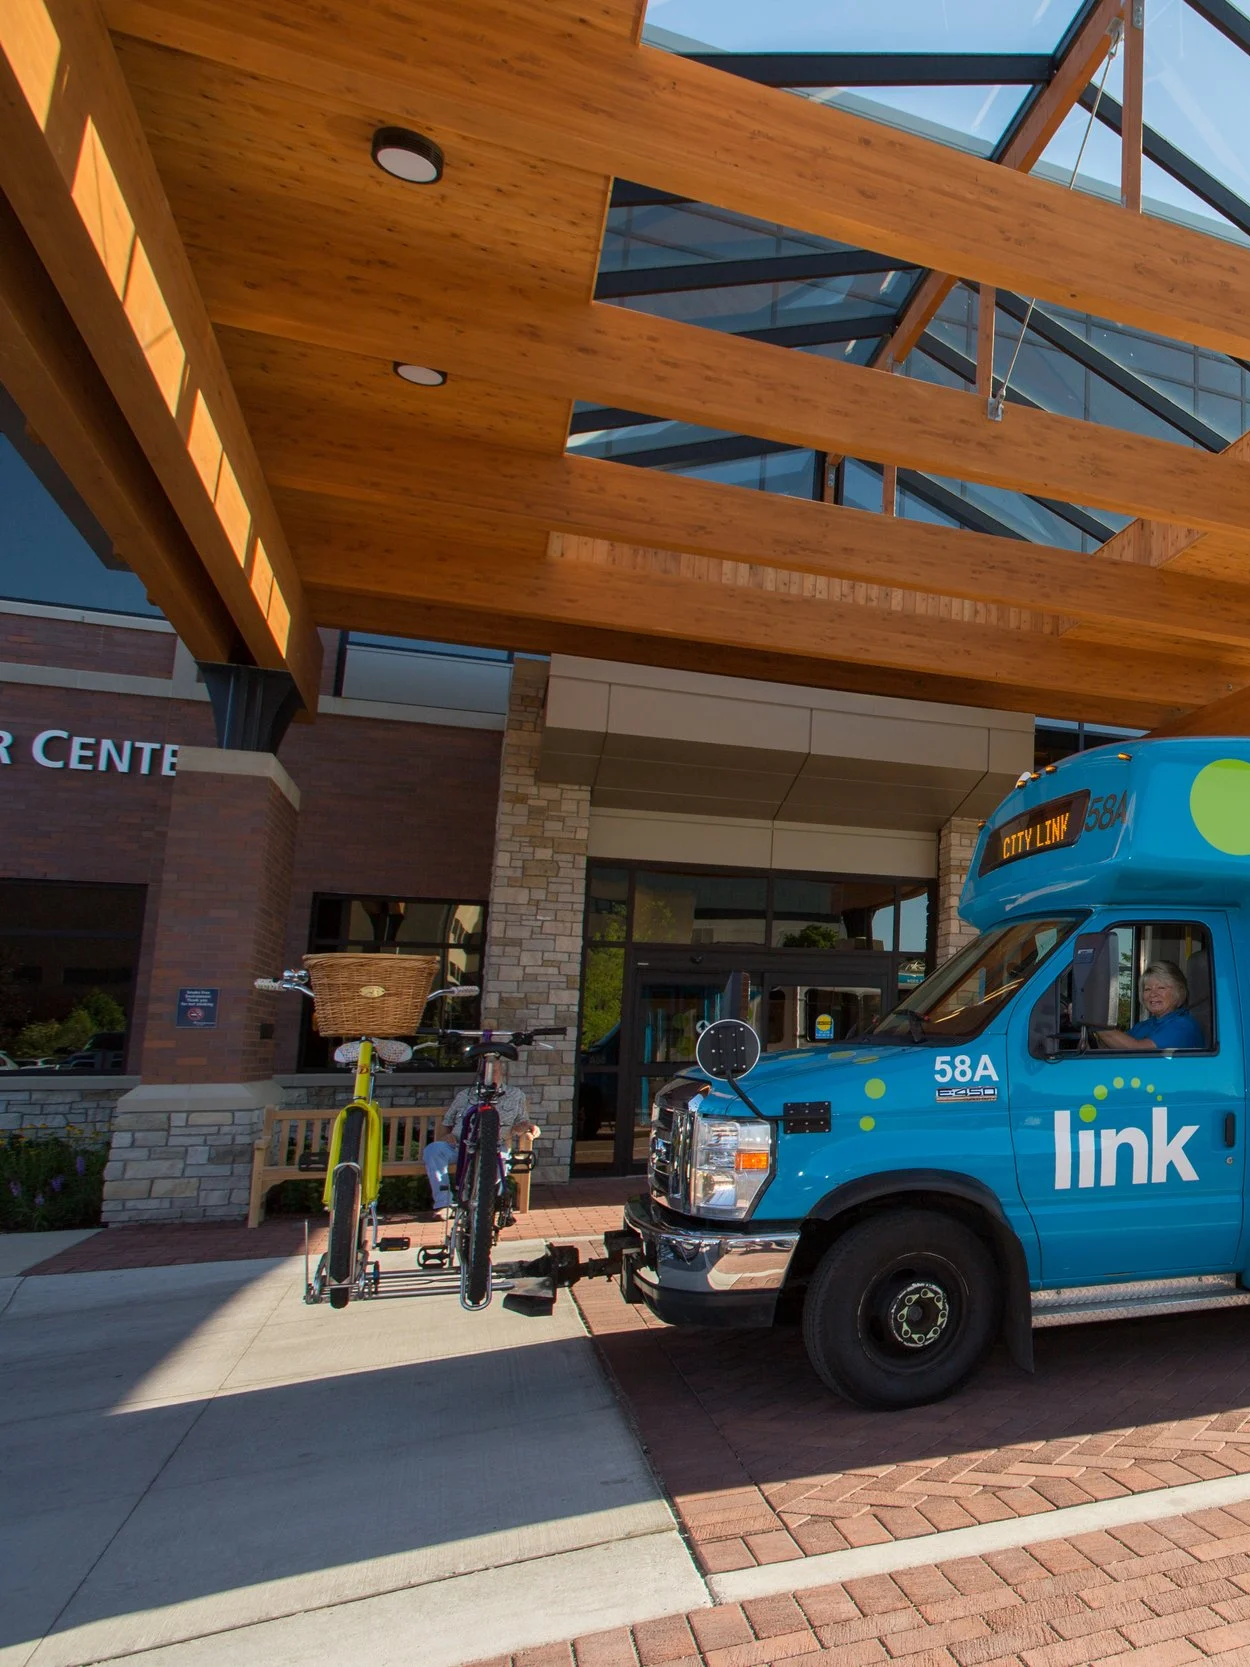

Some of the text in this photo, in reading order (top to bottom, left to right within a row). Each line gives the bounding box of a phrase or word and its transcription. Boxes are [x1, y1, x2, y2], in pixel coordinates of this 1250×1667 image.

[1083, 789, 1129, 833] 58A
[1002, 812, 1070, 860] CITY LINK
[934, 1054, 999, 1083] 58A
[1054, 1104, 1200, 1190] link
